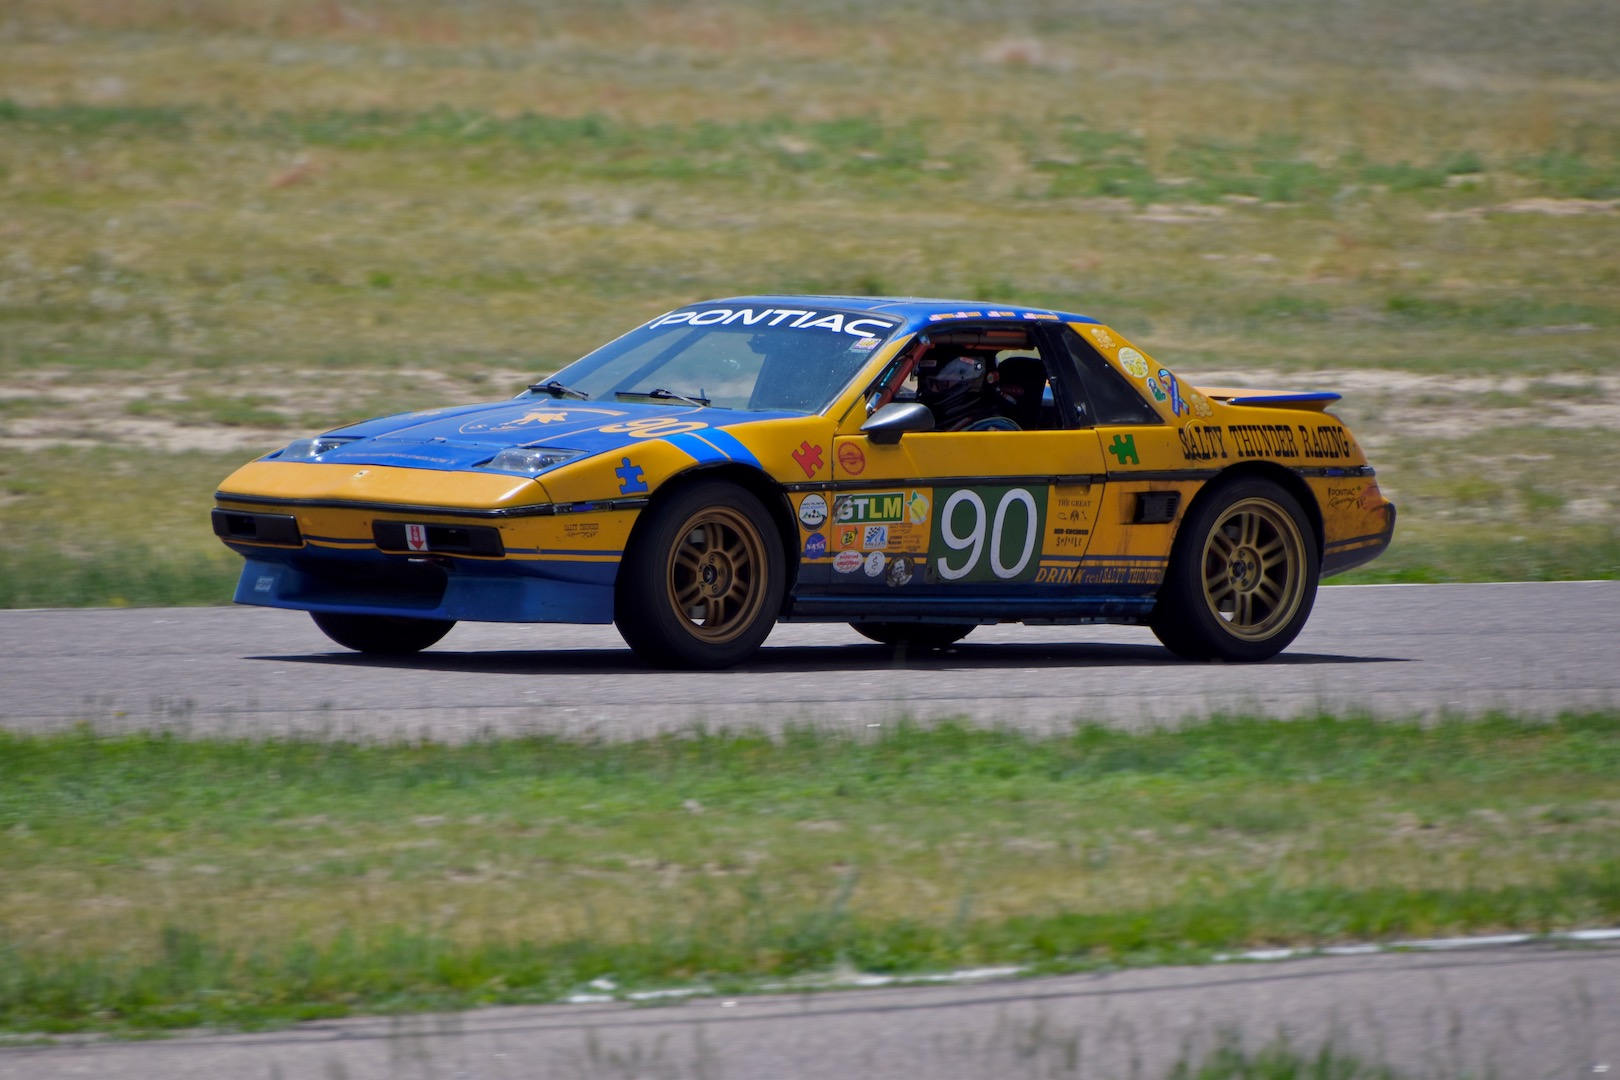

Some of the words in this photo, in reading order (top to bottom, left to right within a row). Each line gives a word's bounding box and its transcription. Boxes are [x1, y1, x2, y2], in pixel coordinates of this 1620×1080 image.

[650, 309, 893, 338] PONTIAC
[599, 418, 708, 438] 90
[1178, 426, 1228, 460] SALTY
[1228, 425, 1299, 458] THUNDER
[1299, 425, 1350, 458] RACING
[836, 497, 902, 520] GTLM
[1058, 500, 1070, 508] THE
[1071, 500, 1092, 508] GREAT
[411, 526, 420, 541] TOW
[937, 488, 1038, 580] 90
[1035, 568, 1087, 584] DRINK
[1101, 569, 1126, 584] SALTY
